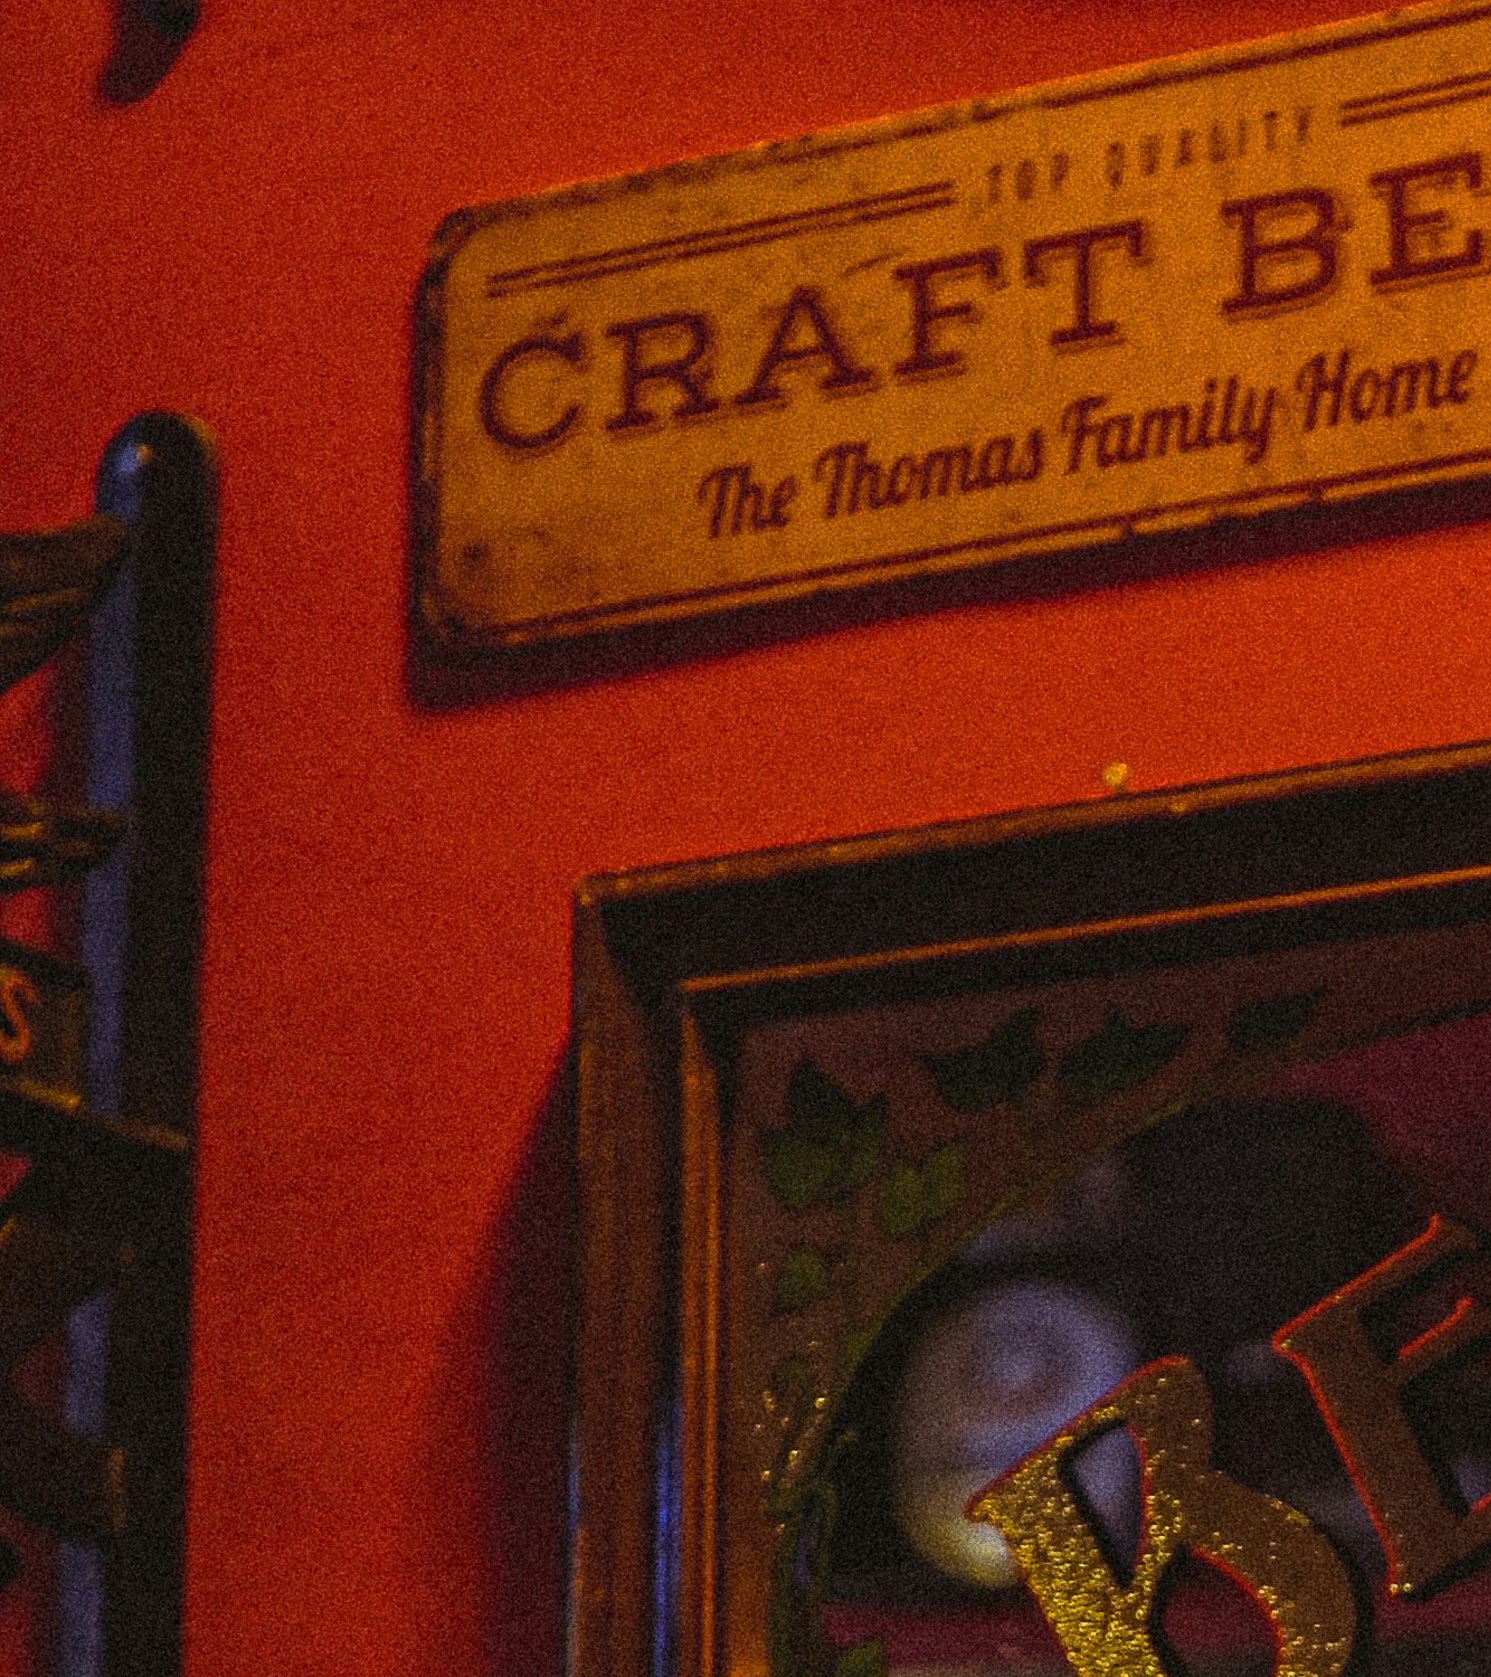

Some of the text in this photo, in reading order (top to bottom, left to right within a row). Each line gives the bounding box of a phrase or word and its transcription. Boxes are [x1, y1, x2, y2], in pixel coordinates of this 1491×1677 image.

[476, 221, 1150, 456] CRAFT
[694, 466, 798, 541] The
[811, 429, 1047, 520] Thomas
[1059, 373, 1280, 474] Family
[1295, 347, 1478, 431] Home
